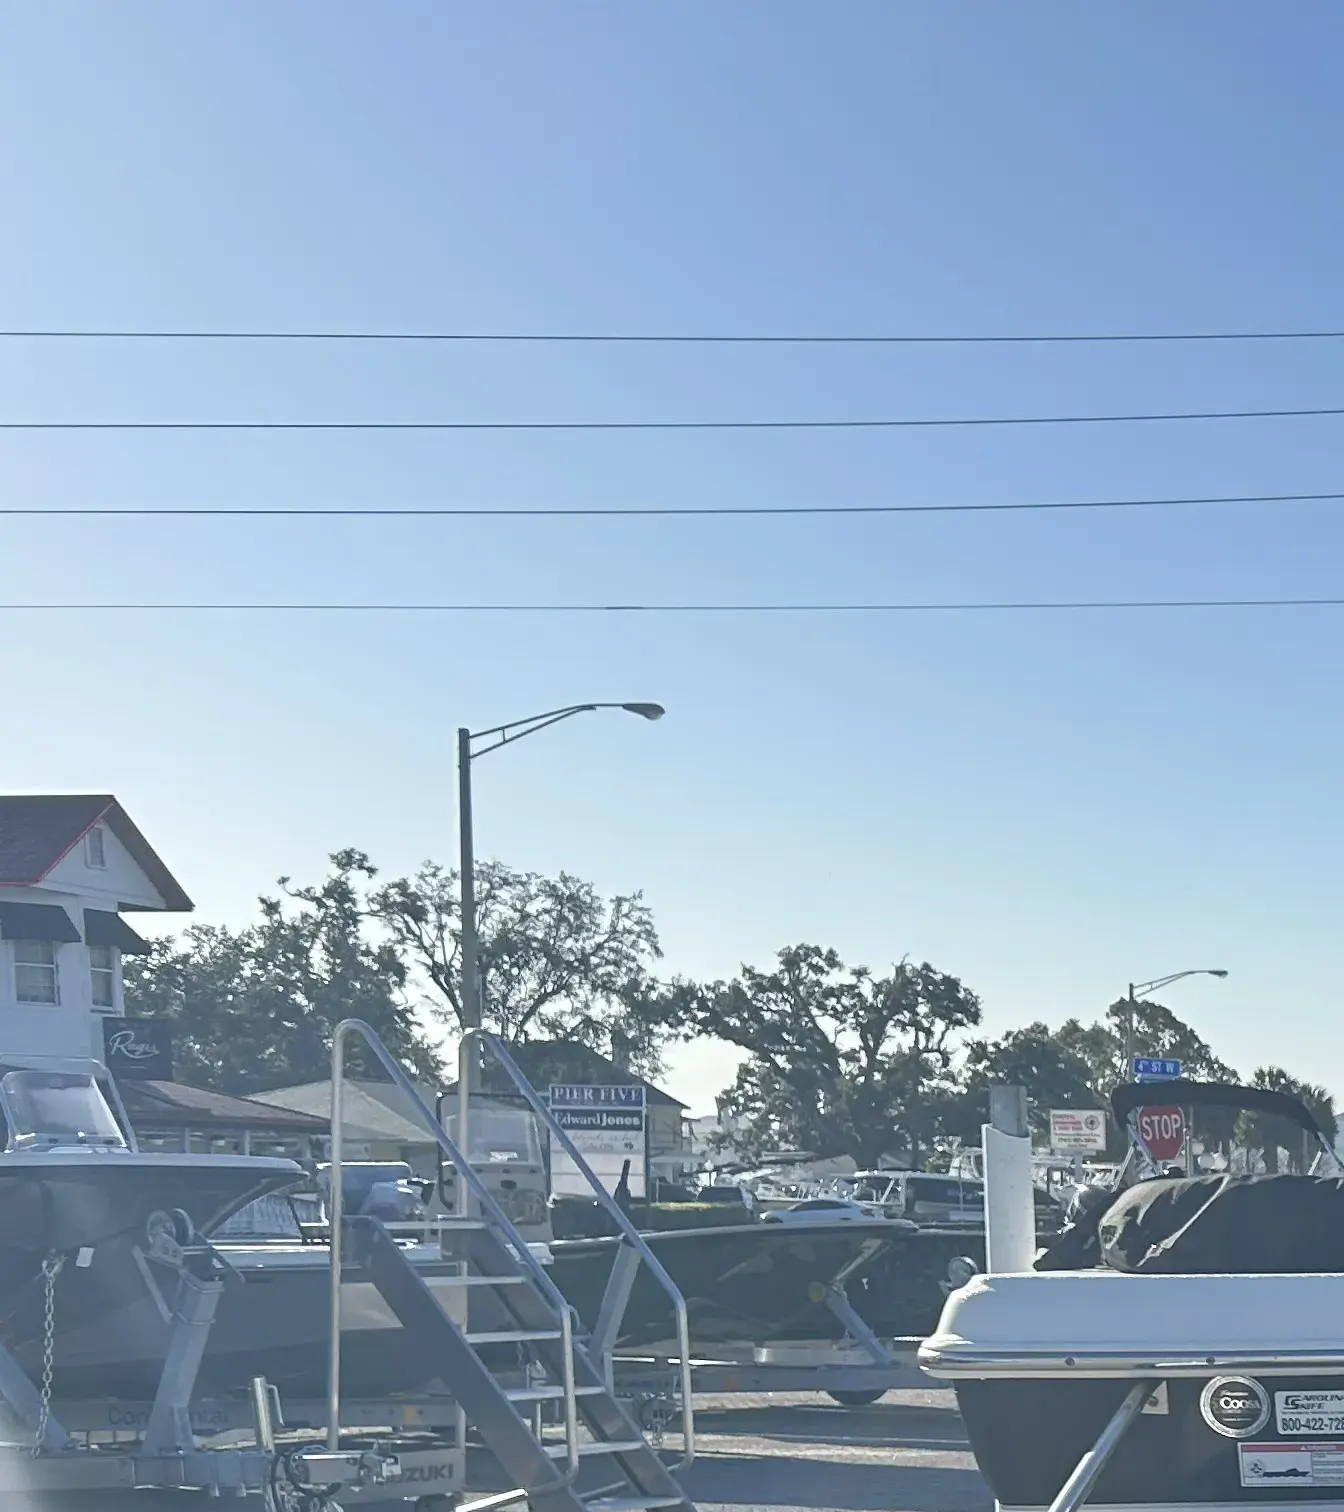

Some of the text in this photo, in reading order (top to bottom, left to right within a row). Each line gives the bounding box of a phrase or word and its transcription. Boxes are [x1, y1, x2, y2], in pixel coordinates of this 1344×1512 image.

[1151, 1062, 1163, 1073] ST
[1165, 1062, 1175, 1074] W
[554, 1087, 641, 1102] PIER FIVE
[601, 1112, 641, 1127] Jones
[1142, 1113, 1181, 1141] STOP
